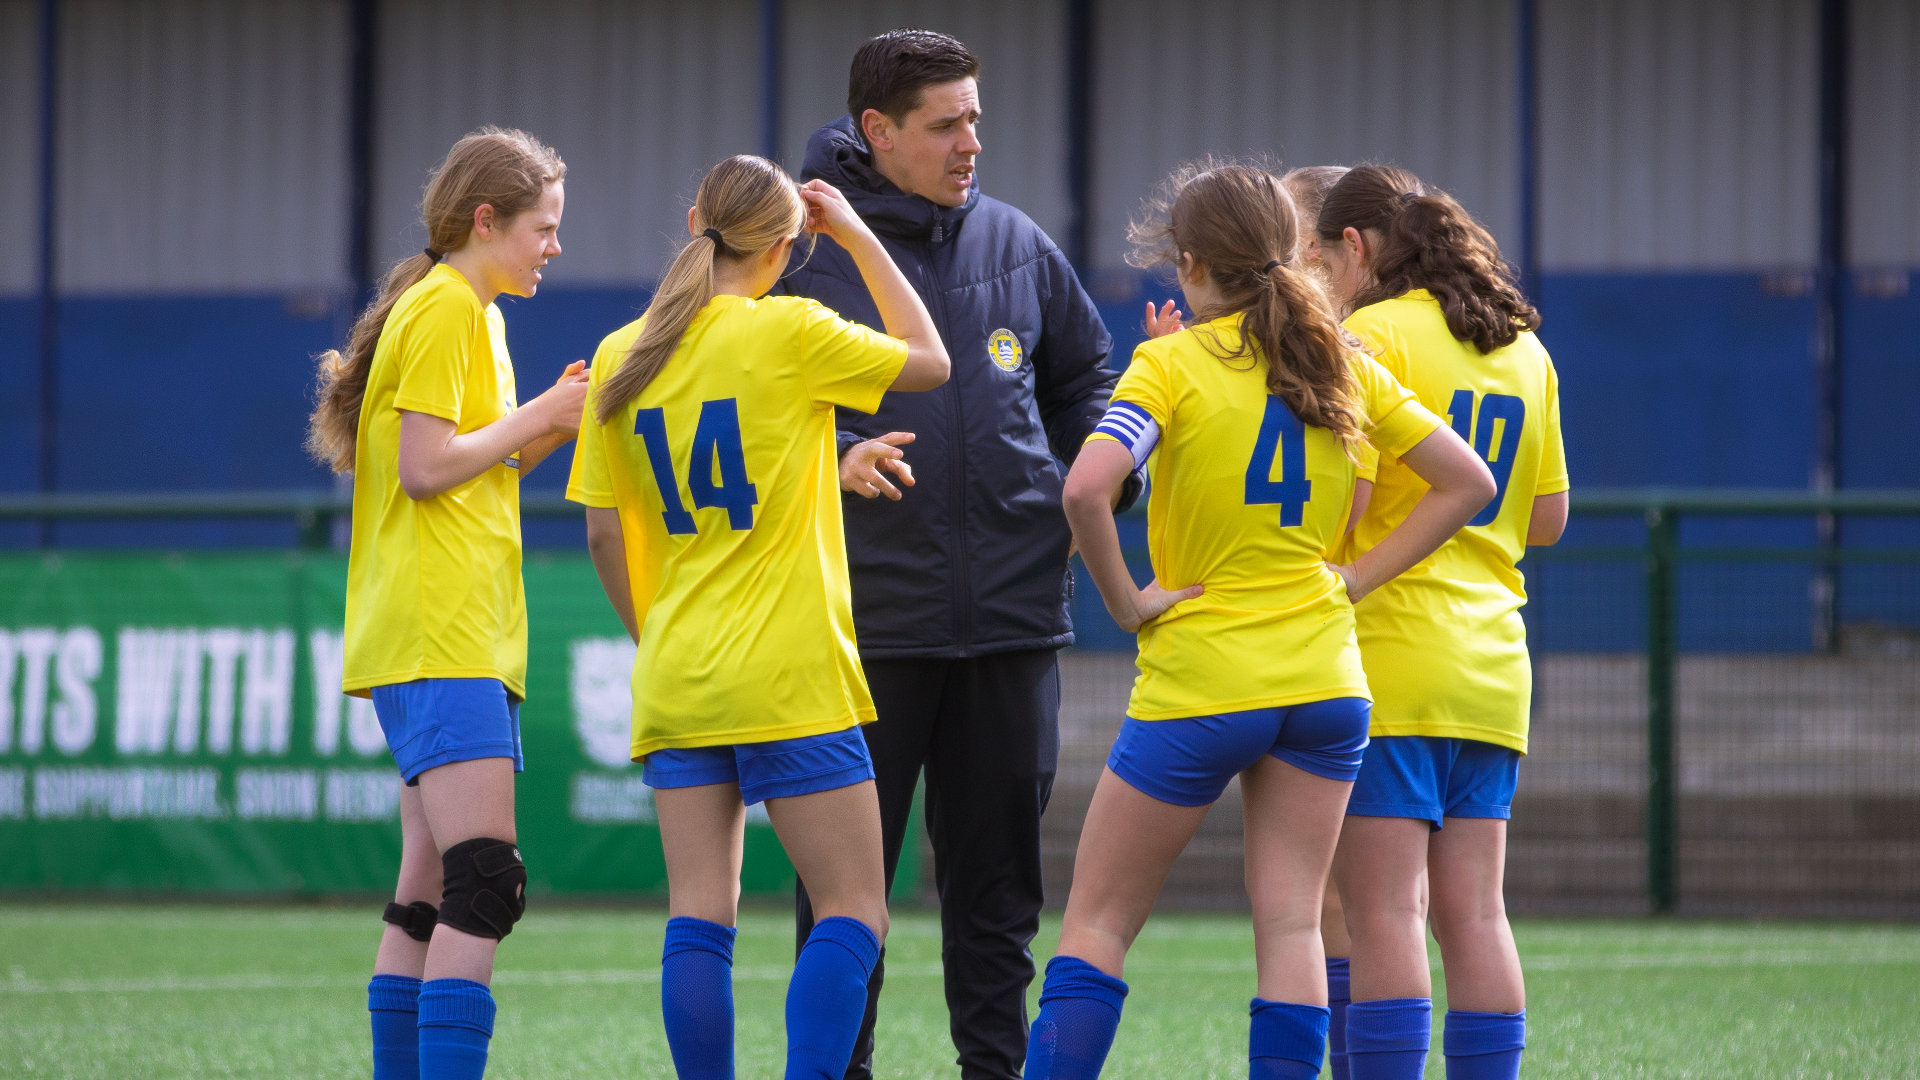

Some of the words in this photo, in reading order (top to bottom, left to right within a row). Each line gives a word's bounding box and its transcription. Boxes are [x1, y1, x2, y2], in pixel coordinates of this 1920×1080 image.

[634, 397, 758, 535] 14
[1244, 393, 1311, 527] 4
[116, 627, 295, 756] WITH
